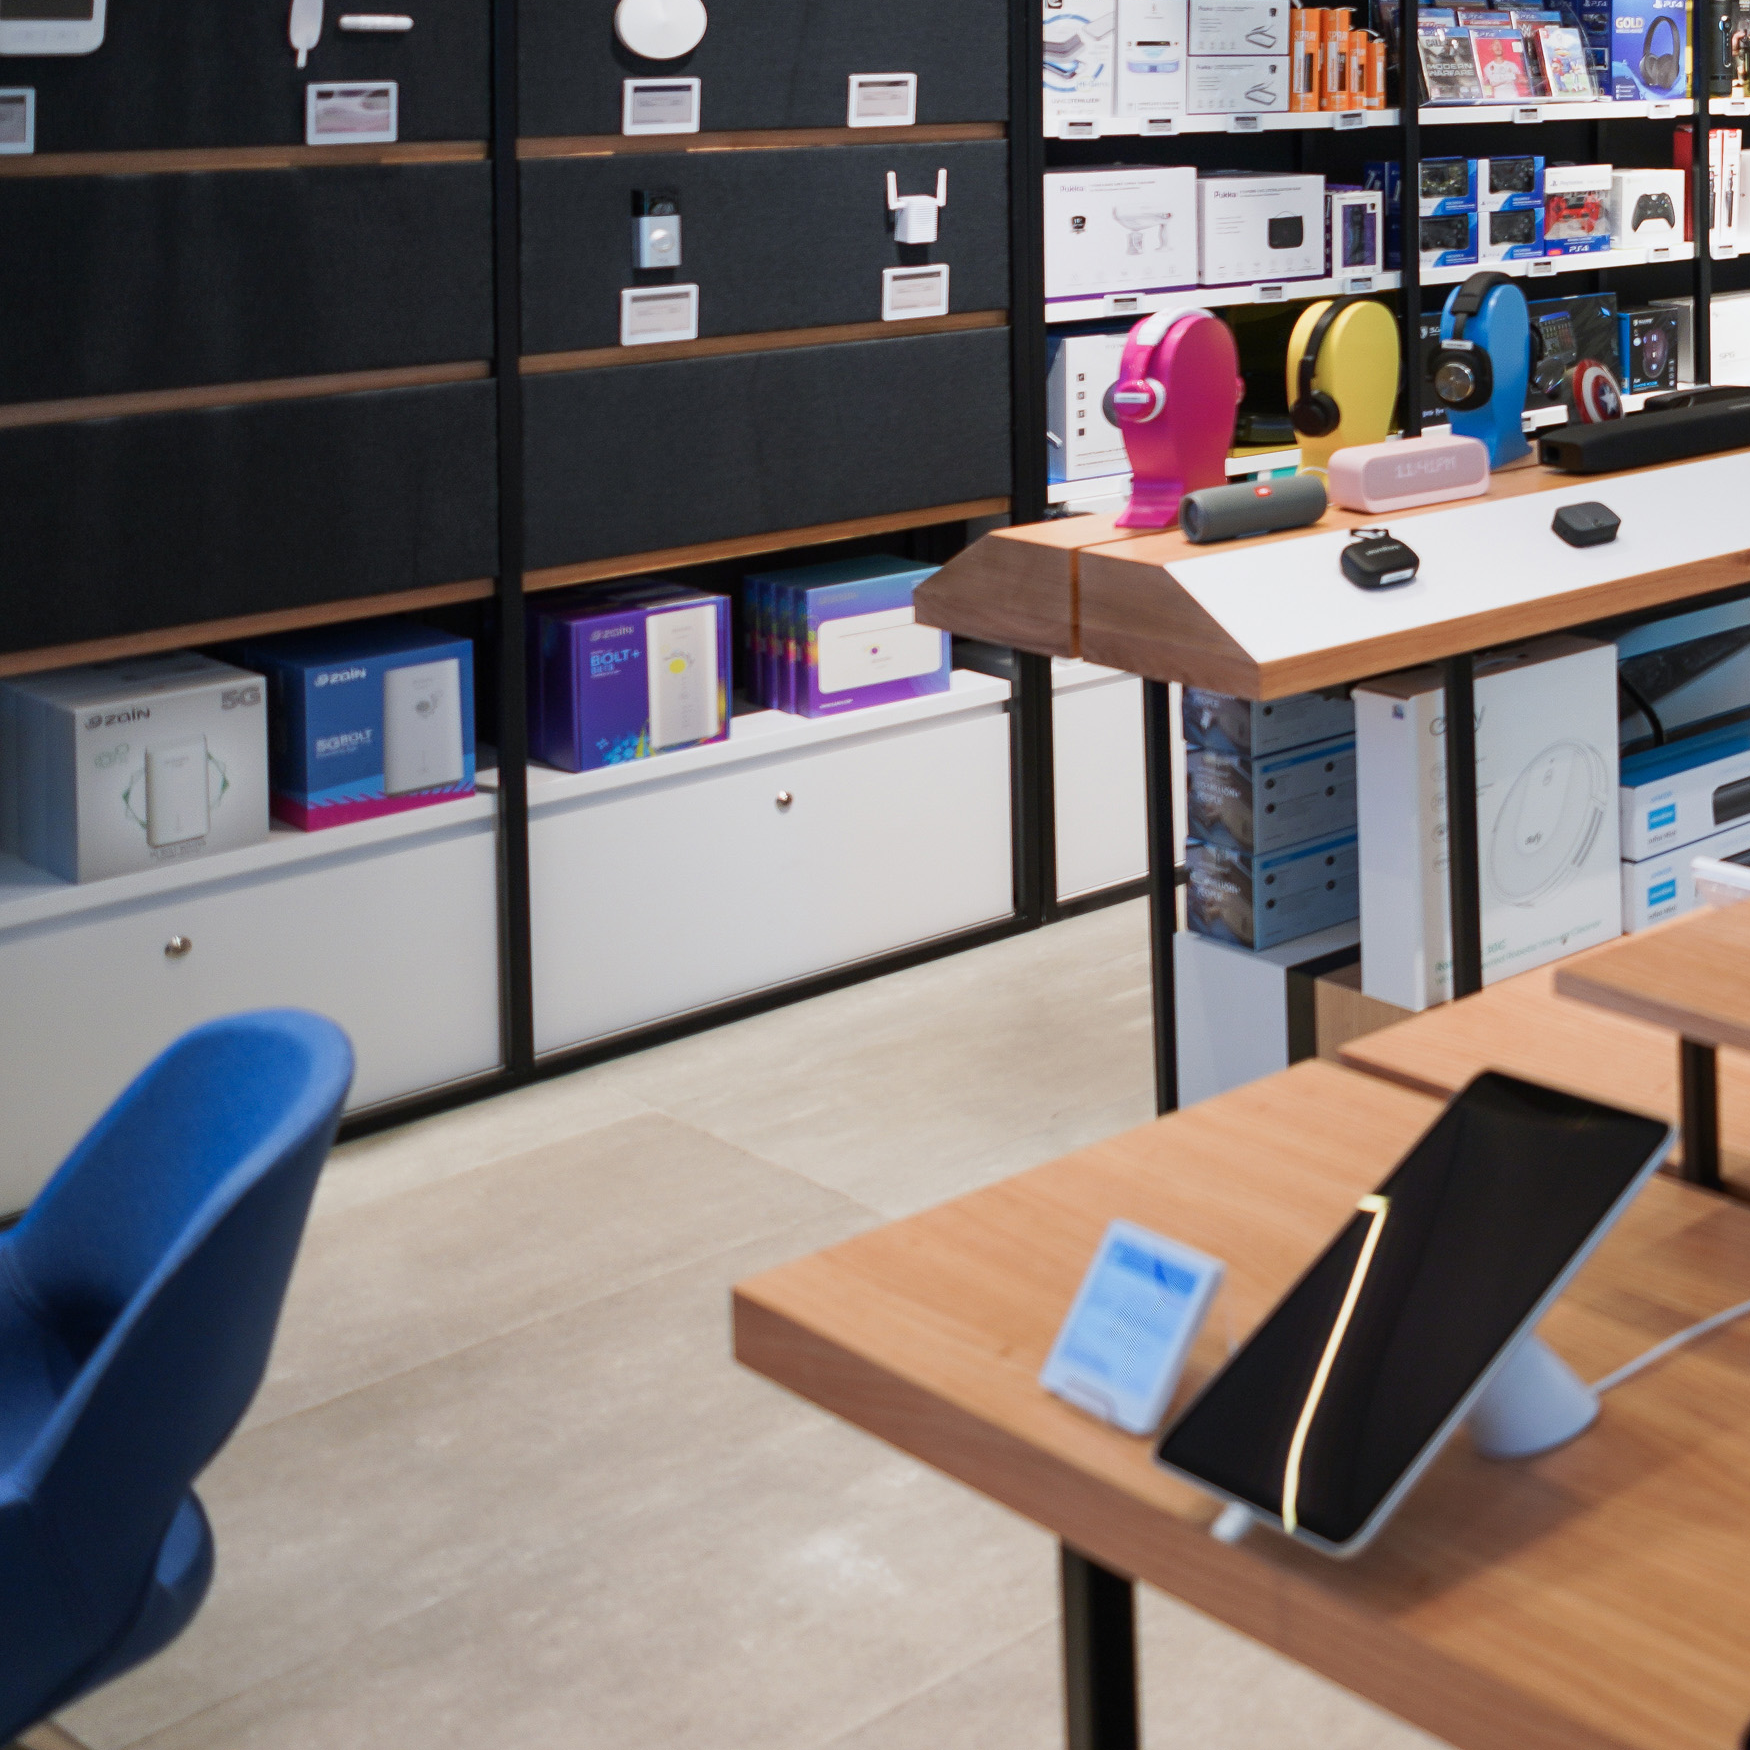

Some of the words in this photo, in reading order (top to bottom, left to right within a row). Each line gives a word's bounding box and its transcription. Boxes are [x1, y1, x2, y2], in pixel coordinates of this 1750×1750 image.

[1663, 0, 1684, 8] PS4
[1615, 16, 1644, 29] GOLD
[1568, 244, 1590, 254] PS4
[221, 686, 262, 711] 5G
[104, 706, 151, 728] zain
[1429, 705, 1486, 737] ey
